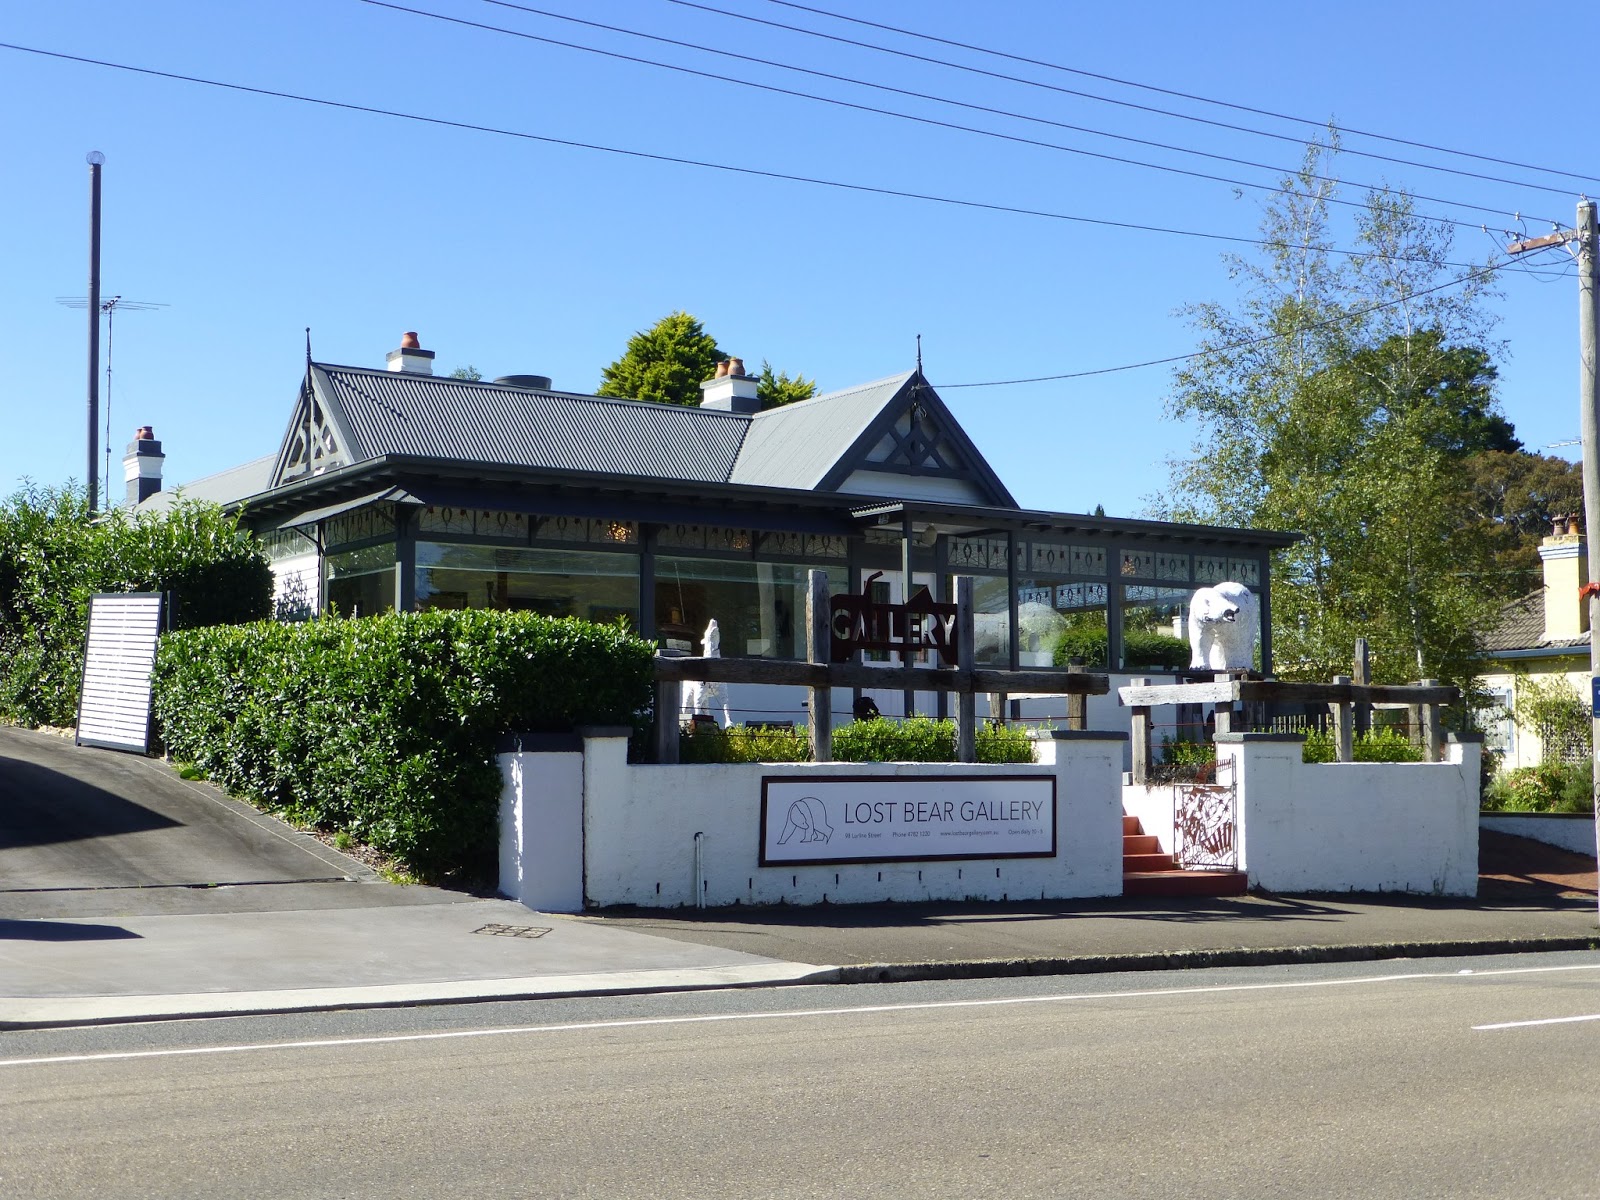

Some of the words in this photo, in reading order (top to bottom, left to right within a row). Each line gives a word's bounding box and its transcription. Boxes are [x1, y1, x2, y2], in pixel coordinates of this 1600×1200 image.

[831, 608, 956, 646] GALLERY
[845, 802, 897, 823] LOST
[904, 801, 953, 822] BEAR
[960, 800, 1043, 821] GALLERY
